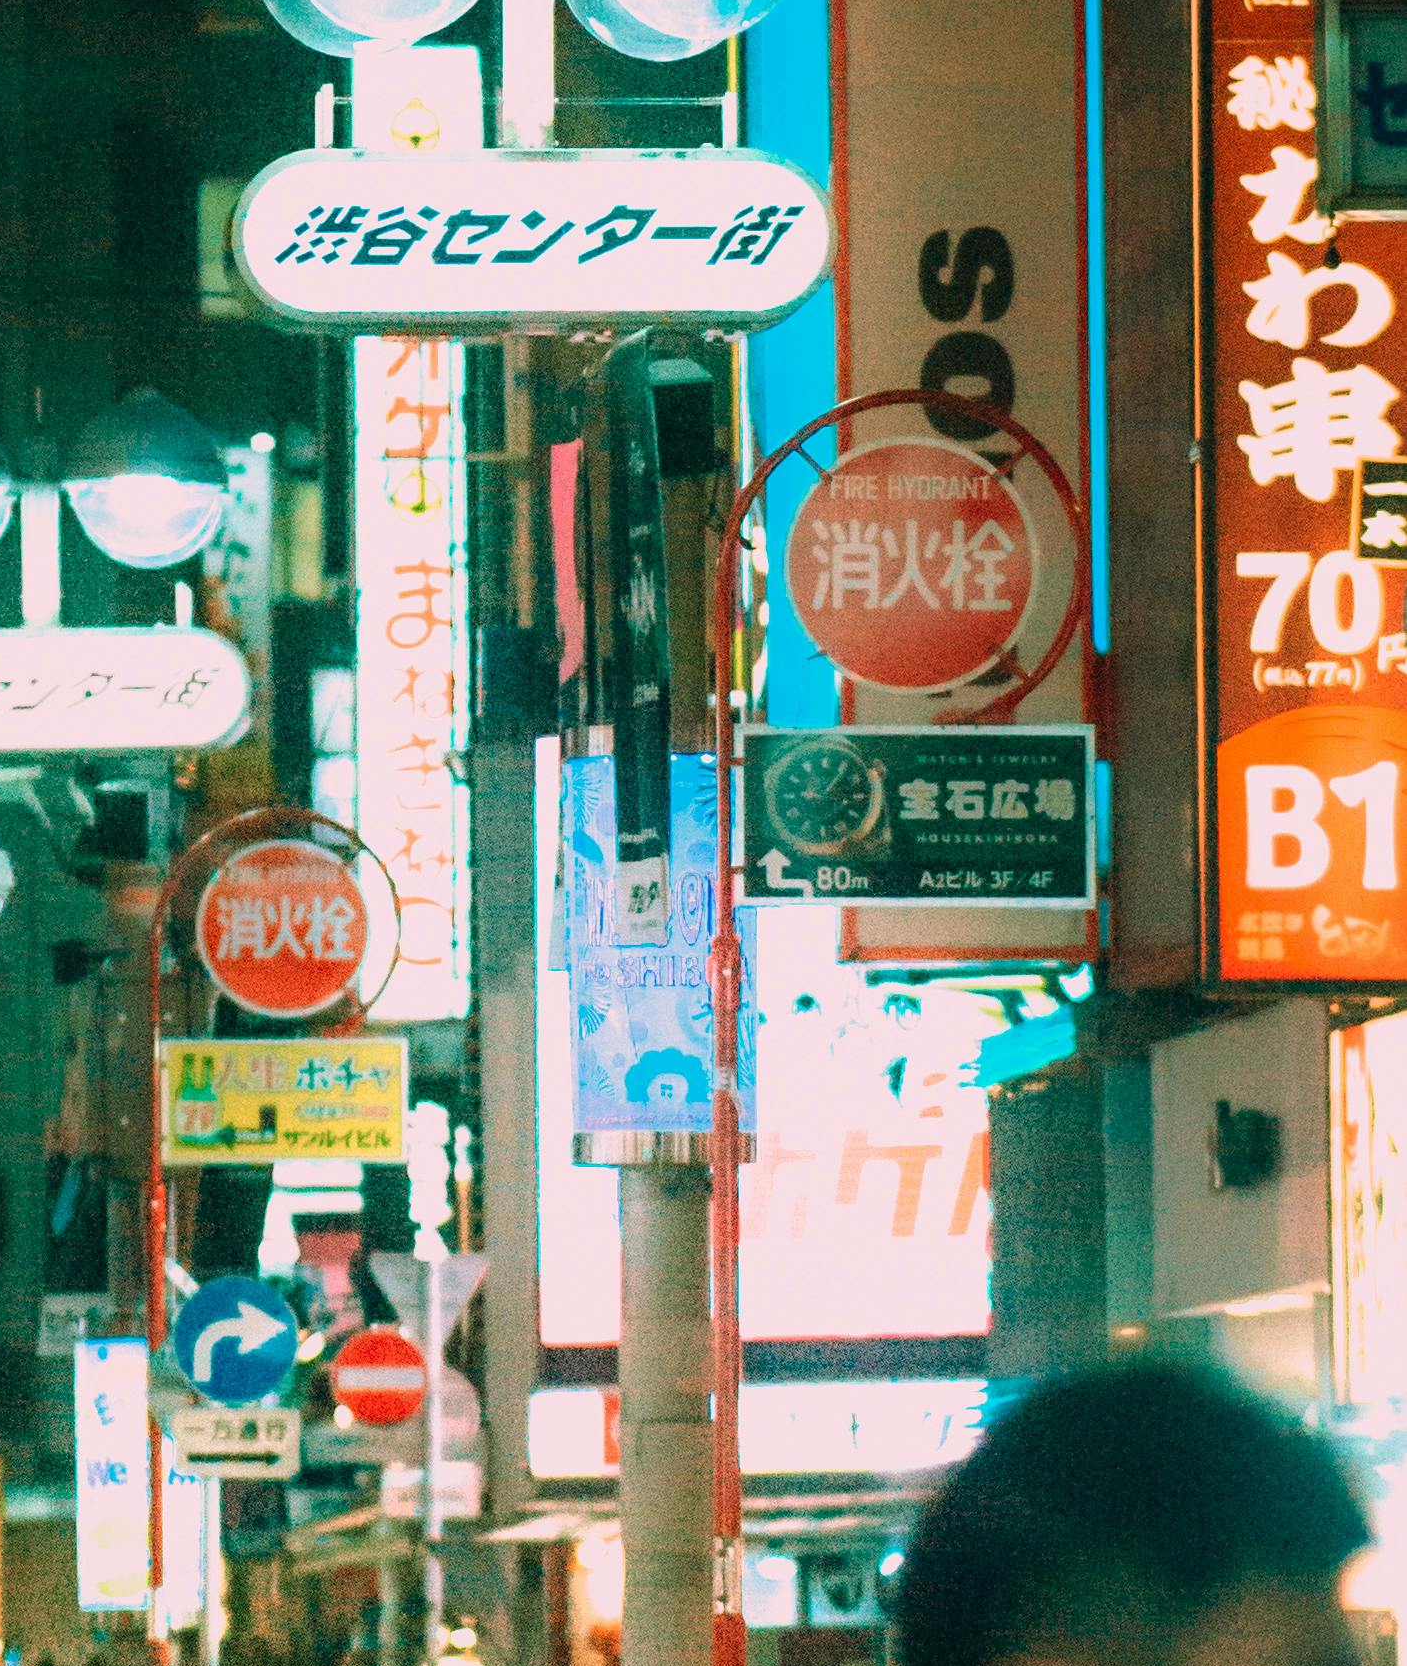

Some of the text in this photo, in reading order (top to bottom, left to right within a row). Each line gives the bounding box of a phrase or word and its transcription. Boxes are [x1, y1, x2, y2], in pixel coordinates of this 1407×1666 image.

[275, 205, 805, 265] 渋谷センター街
[830, 475, 991, 500] FIRE HYDRANT
[811, 519, 1015, 611] 消火栓
[898, 778, 1076, 821] 宝石広場
[1244, 760, 1398, 891] B1
[816, 866, 869, 891] 80m
[217, 894, 355, 962] 消火栓
[184, 1417, 288, 1443] 一方通行
